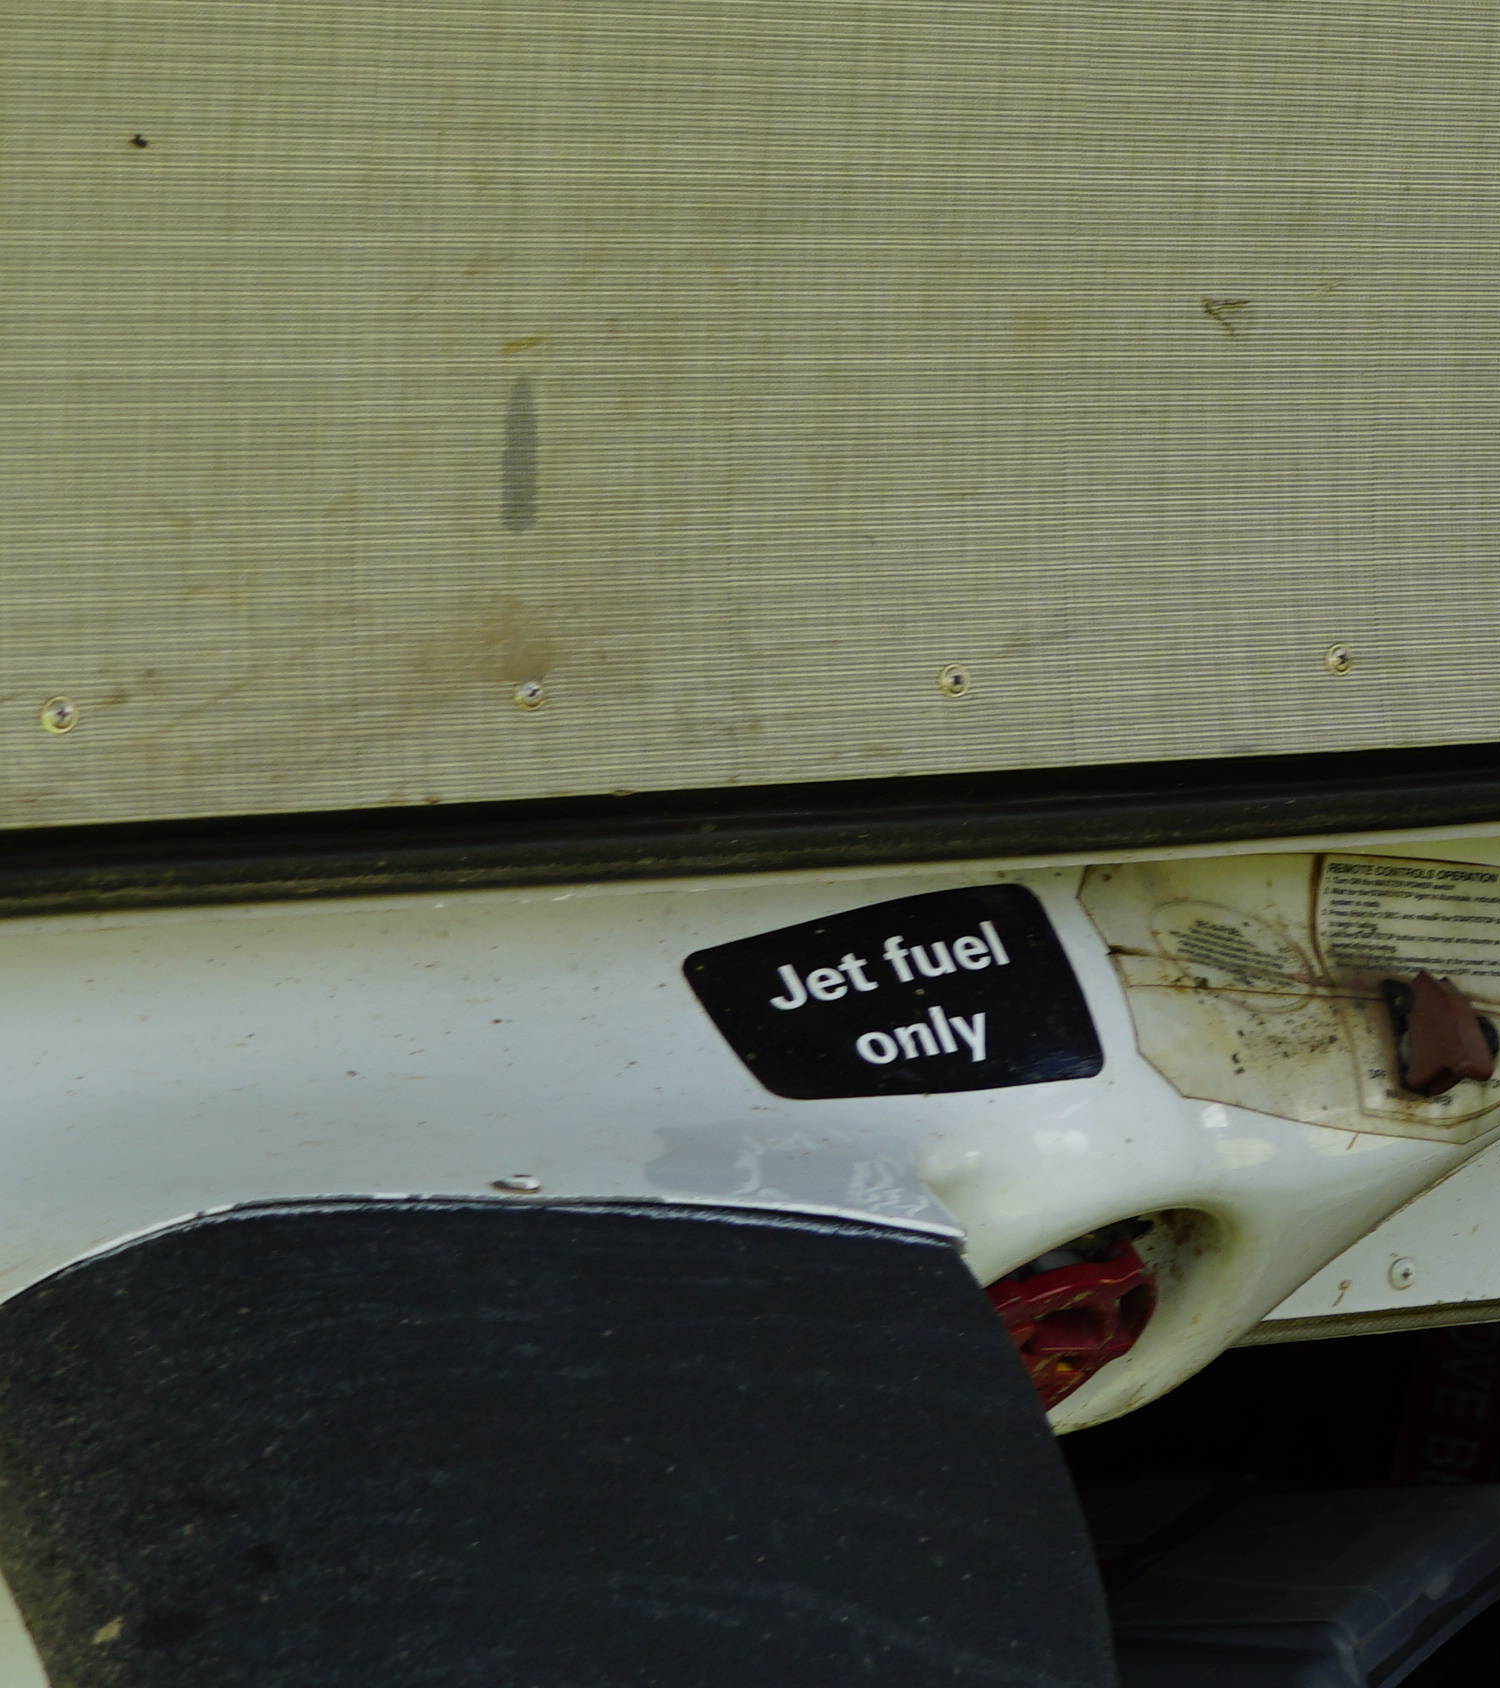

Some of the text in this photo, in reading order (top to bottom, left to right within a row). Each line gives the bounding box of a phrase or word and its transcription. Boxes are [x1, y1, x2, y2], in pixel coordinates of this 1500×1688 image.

[769, 920, 1011, 1011] Jet fuel
[855, 1005, 987, 1065] only
